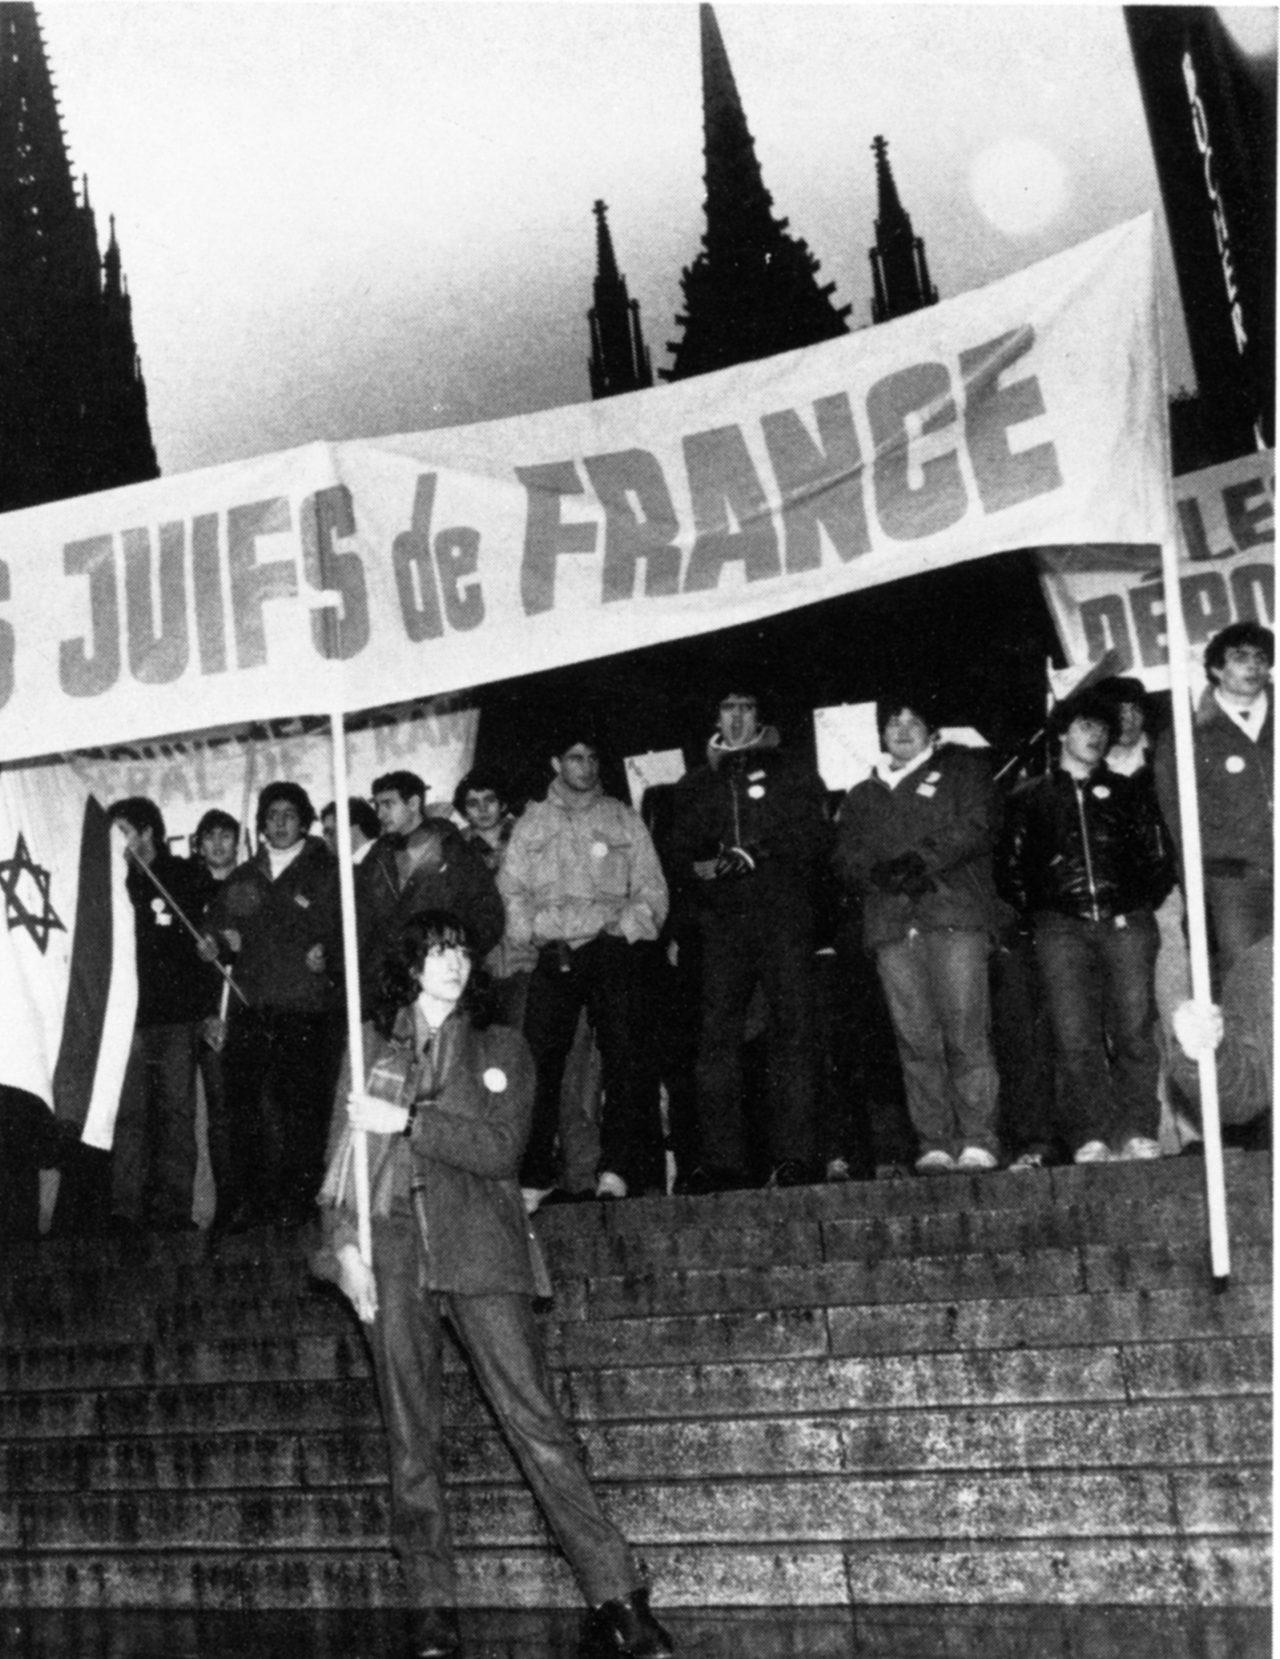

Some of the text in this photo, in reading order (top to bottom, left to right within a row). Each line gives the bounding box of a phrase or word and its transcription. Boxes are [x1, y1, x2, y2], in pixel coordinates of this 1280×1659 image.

[58, 483, 371, 698] JUIFS
[391, 472, 486, 644] de
[513, 323, 1064, 617] FRANCE
[1176, 475, 1275, 562] LE
